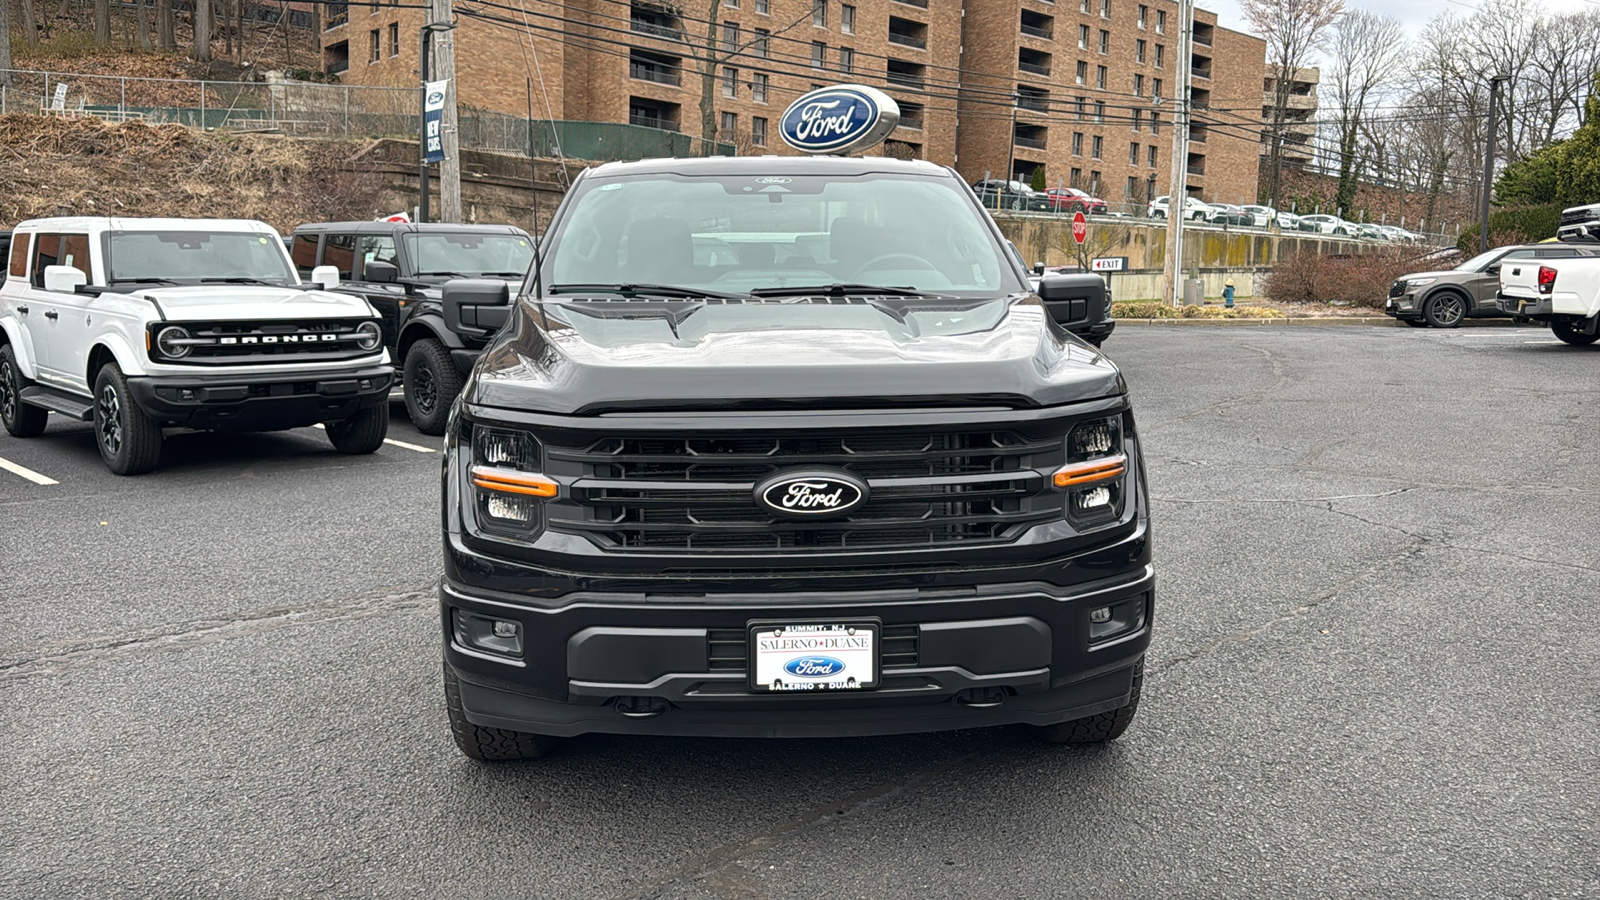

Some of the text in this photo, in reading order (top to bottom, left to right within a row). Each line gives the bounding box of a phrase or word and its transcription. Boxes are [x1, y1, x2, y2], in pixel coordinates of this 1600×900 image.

[796, 100, 855, 140] Ford
[427, 120, 440, 137] NEW
[427, 136, 441, 152] CARS
[1073, 221, 1086, 234] STOP
[1102, 260, 1119, 269] EXIT
[220, 334, 337, 345] BRONCO
[782, 482, 843, 508] Ford
[831, 624, 846, 632] NJ
[760, 637, 869, 651] SALERNO DUANE
[795, 659, 833, 675] Ford
[768, 681, 862, 691] SALERNO DUANE
